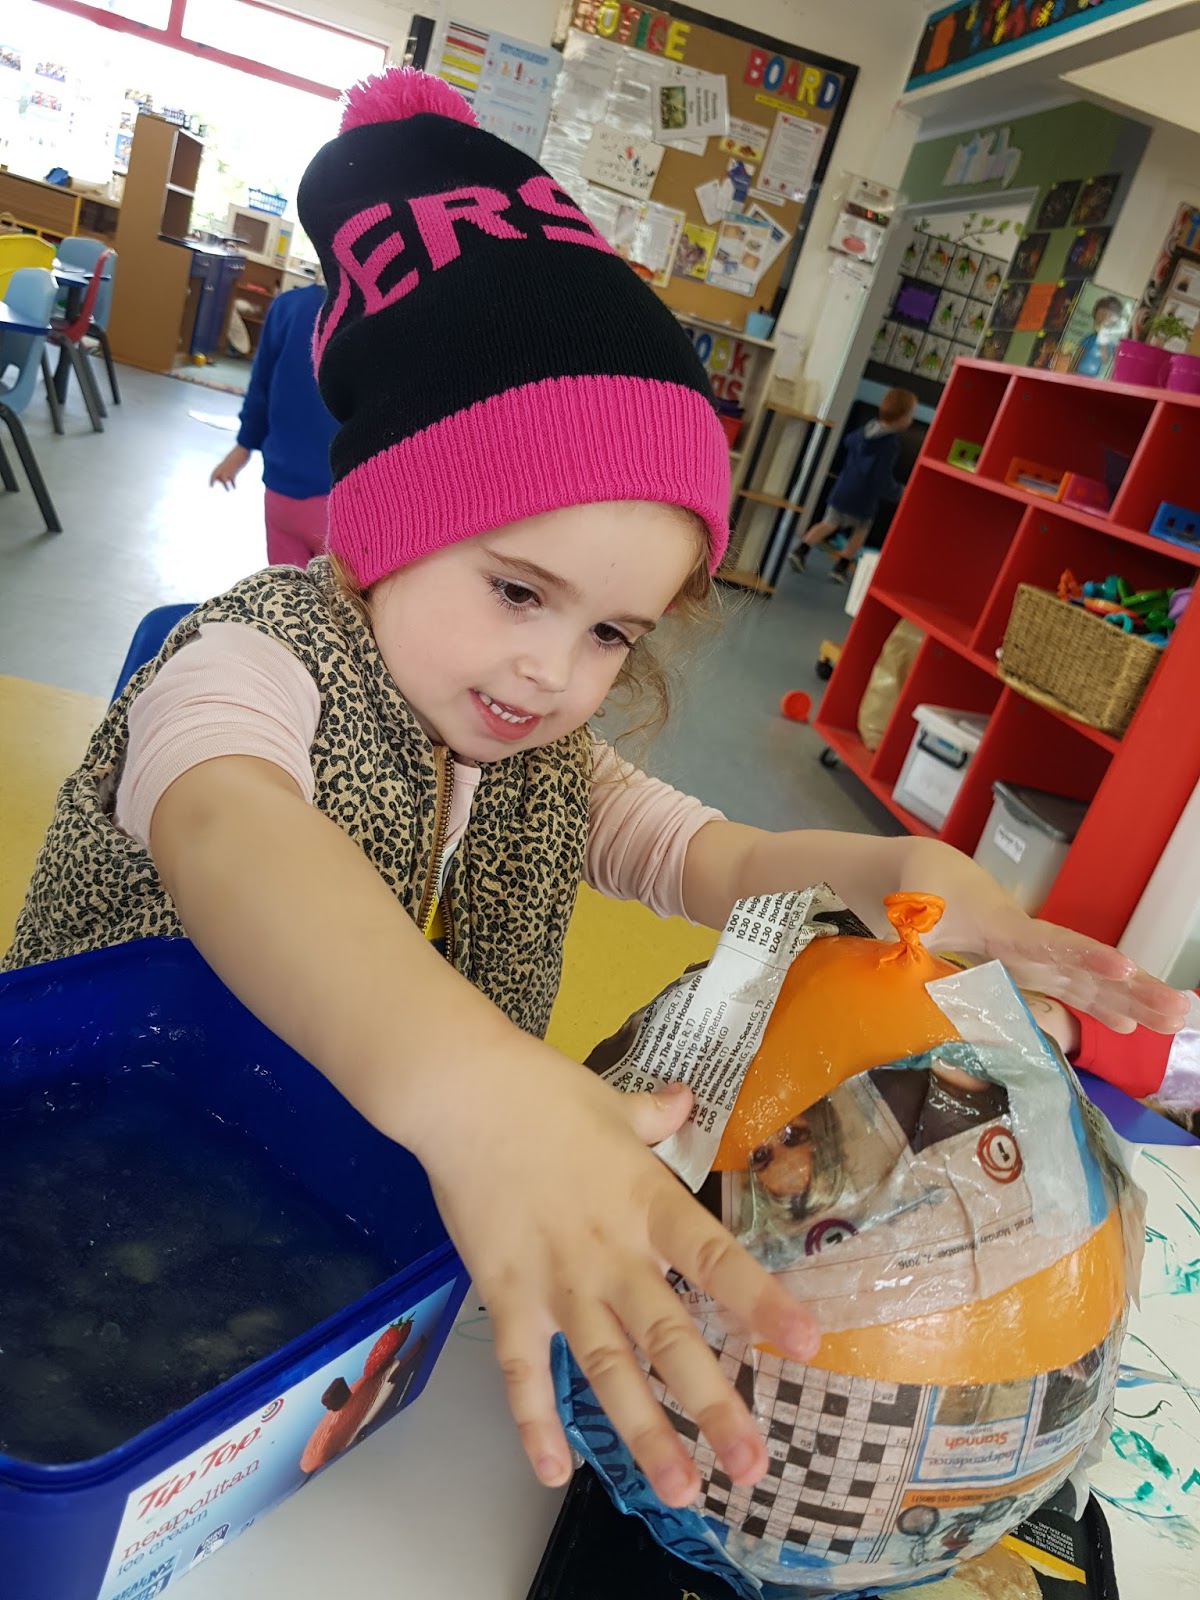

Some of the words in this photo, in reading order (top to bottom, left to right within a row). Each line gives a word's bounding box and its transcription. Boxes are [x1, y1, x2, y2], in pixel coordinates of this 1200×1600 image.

[743, 48, 840, 110] BOARD
[727, 913, 739, 932] 9.00
[736, 917, 750, 939] 10.30
[748, 921, 761, 943] 11.00
[757, 896, 771, 918] Home
[759, 926, 772, 946] 11.30
[768, 931, 782, 954] 12.00
[779, 911, 789, 927] The
[641, 1022, 667, 1072] Emmerdale
[664, 999, 678, 1022] (PGR,
[651, 1059, 665, 1078] May
[660, 1041, 671, 1058] The
[668, 1020, 680, 1040] Best
[676, 992, 693, 1020] House
[690, 973, 702, 991] Win
[708, 1001, 726, 1035] (Return)
[633, 1037, 648, 1062] News
[662, 1050, 680, 1083] Abroad
[676, 1037, 686, 1050] (G,
[682, 1028, 691, 1037] R,
[674, 1060, 688, 1083] oach
[685, 1042, 698, 1060] Trip
[693, 1007, 712, 1041] (Return)
[704, 1110, 717, 1132] 5.00
[715, 1088, 728, 1106] The
[724, 1062, 742, 1087] Chase
[751, 1011, 767, 1039] Hosted
[765, 998, 773, 1009] by
[707, 1040, 722, 1061] Point
[718, 1026, 728, 1039] (G)
[696, 1106, 708, 1126] 4.25
[706, 1056, 733, 1102] Millionaire
[731, 1040, 742, 1056] Hot
[740, 1021, 753, 1040] Seat
[697, 1088, 706, 1098] Te
[704, 1058, 722, 1086] Karere
[720, 1046, 729, 1057] (T)
[979, 1227, 1010, 1243] Monday
[898, 1257, 919, 1269] 2016
[945, 1431, 1009, 1449] Stannah
[138, 1469, 196, 1520] Tip
[200, 1427, 261, 1479] Top
[121, 1459, 260, 1562] neapolitan
[116, 1553, 145, 1577] ice
[149, 1510, 208, 1556] cream
